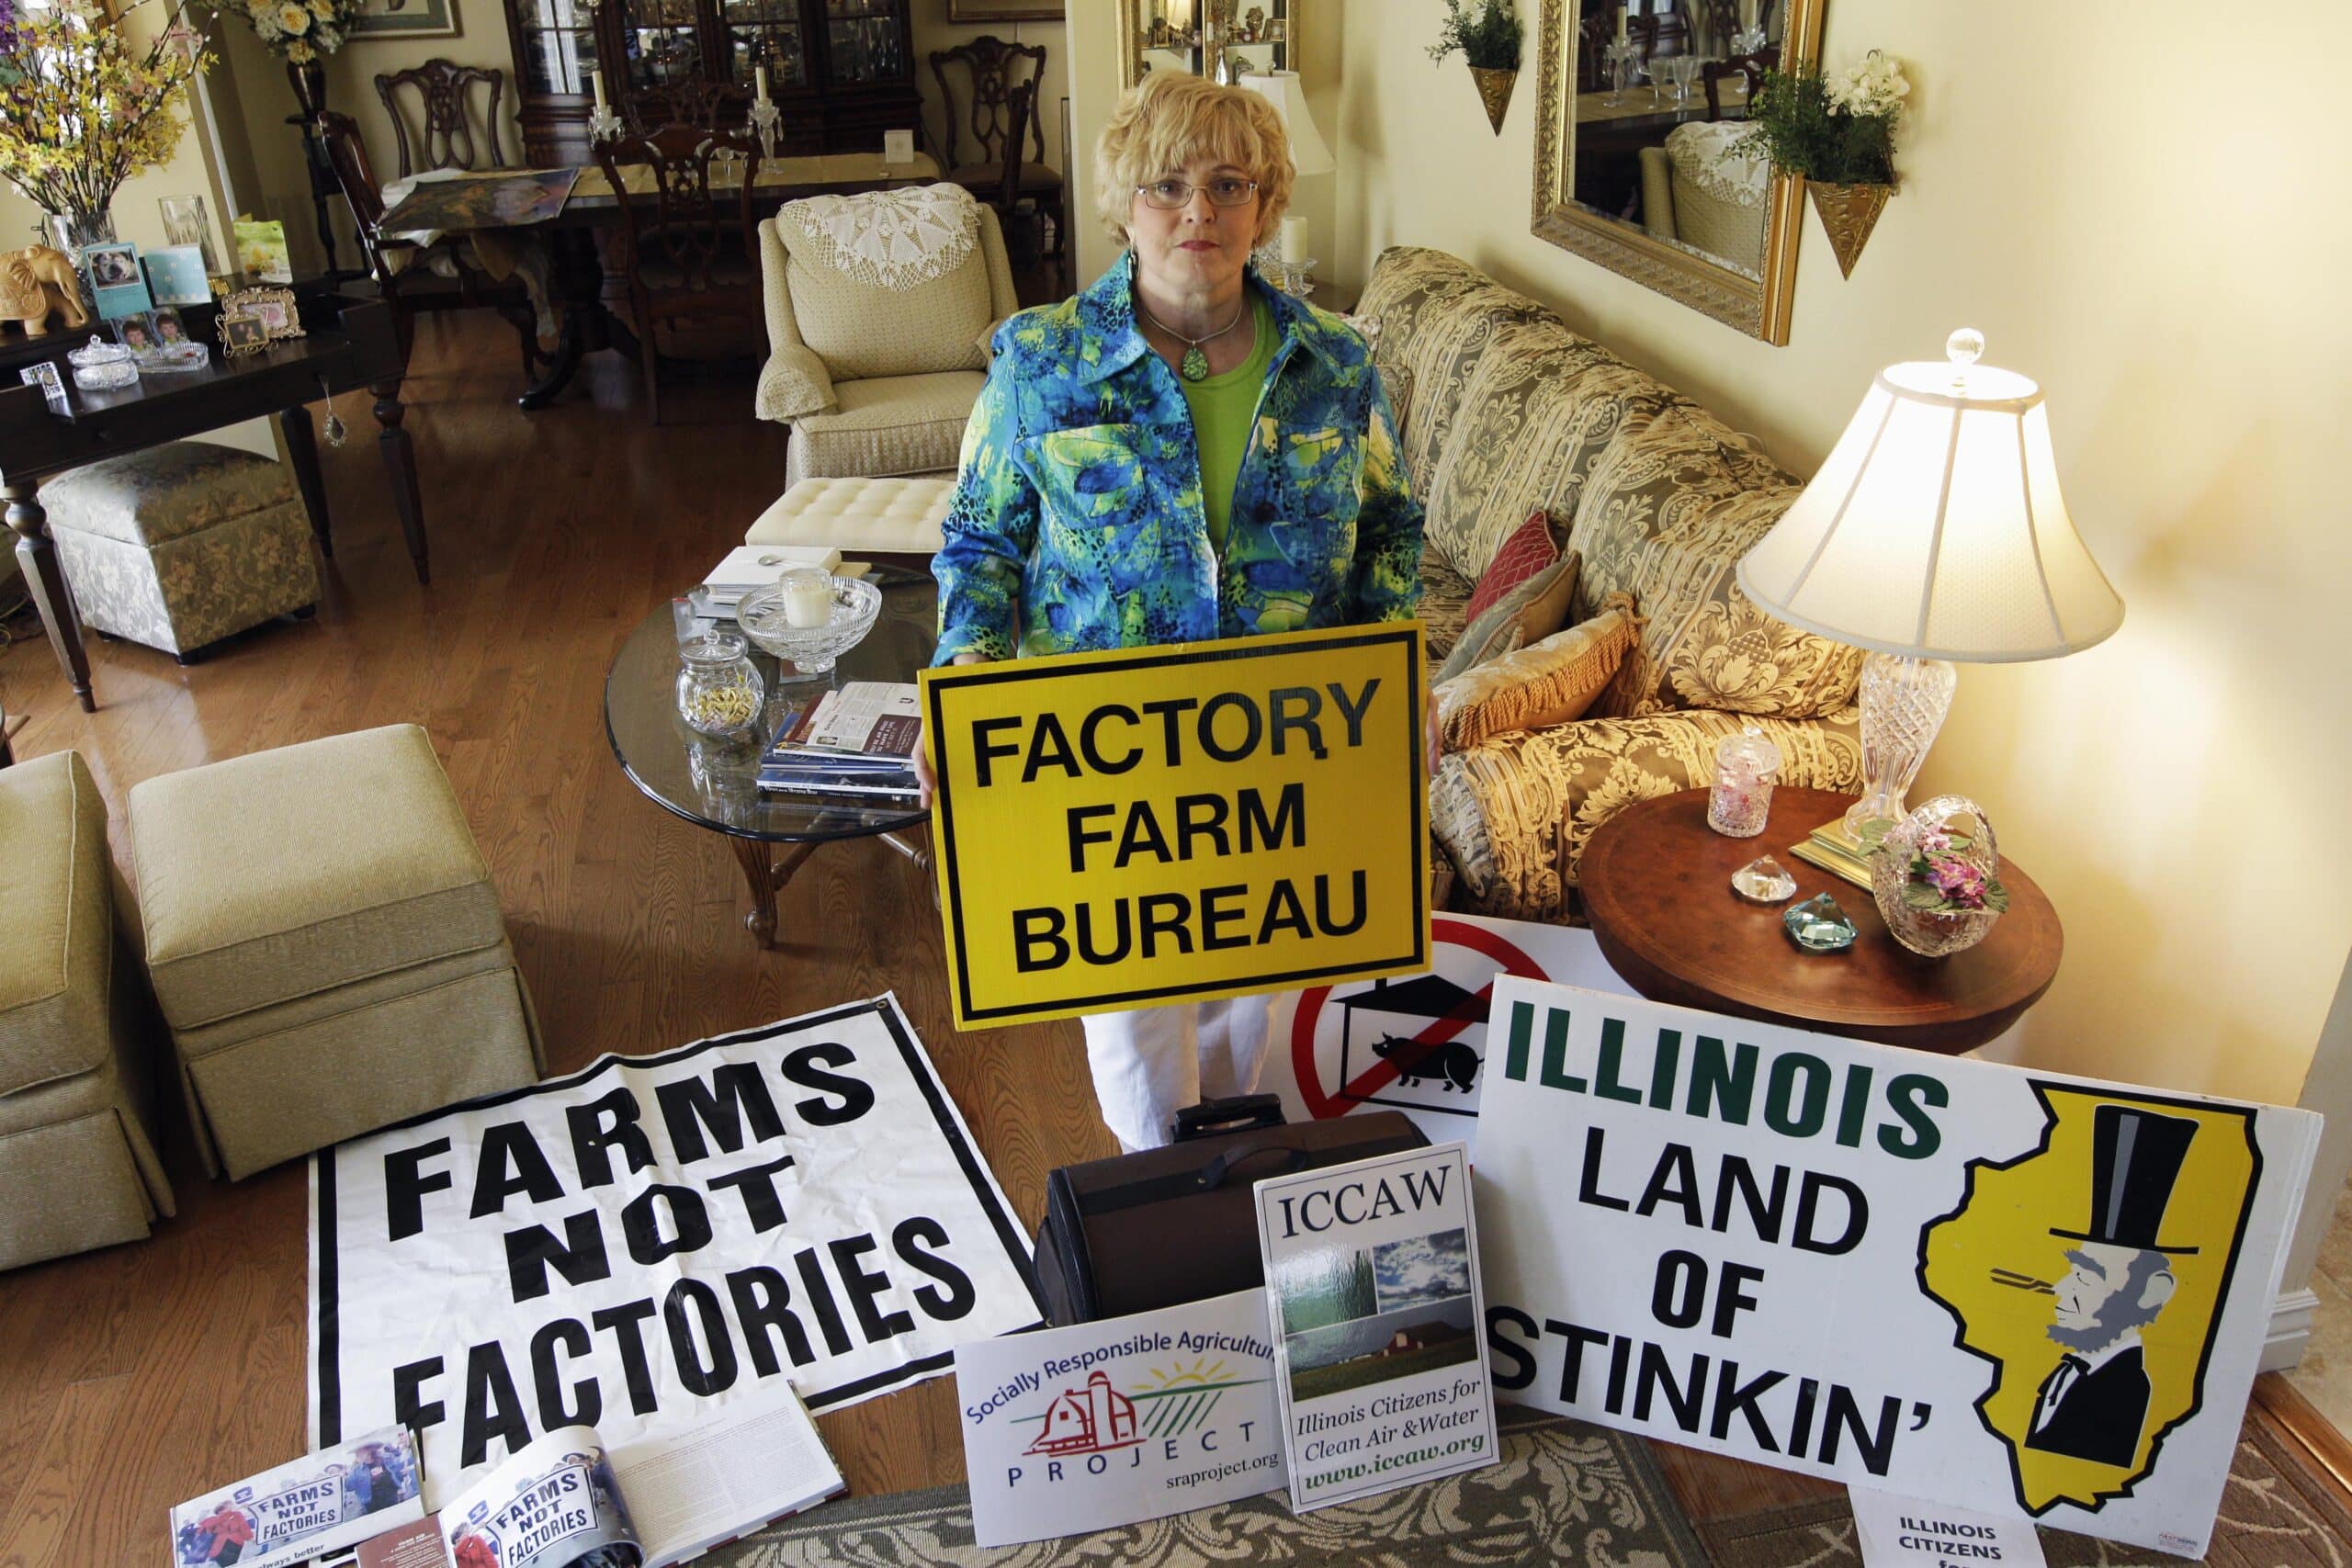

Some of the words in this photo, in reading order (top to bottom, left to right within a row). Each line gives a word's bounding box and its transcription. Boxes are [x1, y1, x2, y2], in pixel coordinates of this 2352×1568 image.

[970, 677, 1382, 788] FACTORY
[1066, 782, 1306, 874] FARM
[1012, 870, 1368, 974] BUREAU
[1504, 1001, 1950, 1160] ILLINOIS
[383, 1042, 876, 1243] FARMS
[1278, 1165, 1452, 1239] ICCAW
[1577, 1126, 1871, 1256] LAND
[503, 1155, 797, 1304] NOT
[1651, 1249, 1764, 1339] OF
[393, 1216, 977, 1483] FACTORIES
[966, 1371, 1041, 1425] Socially
[1043, 1332, 1172, 1380] Responsible
[1177, 1331, 1275, 1362] Agricultur
[1296, 1405, 1366, 1437] Illinois
[1371, 1388, 1447, 1418] Citizens
[1449, 1379, 1481, 1405] for
[1008, 1421, 1256, 1487] PROJECT
[1166, 1452, 1280, 1491] sraproject.org
[1304, 1434, 1485, 1490] www.iccaw.org
[1305, 1437, 1362, 1461] Clean
[1365, 1426, 1398, 1449] Air
[260, 1482, 334, 1513] FARMS
[263, 1509, 336, 1540] FACTORIES
[278, 1502, 318, 1520] NOT
[496, 1472, 579, 1529] FARMS
[518, 1499, 561, 1533] NOT
[259, 1556, 291, 1568] lways
[294, 1544, 324, 1559] better
[508, 1508, 587, 1565] FACTORIES
[1898, 1536, 2003, 1561] CITIZENS
[1900, 1517, 1996, 1540] ILLINOIS
